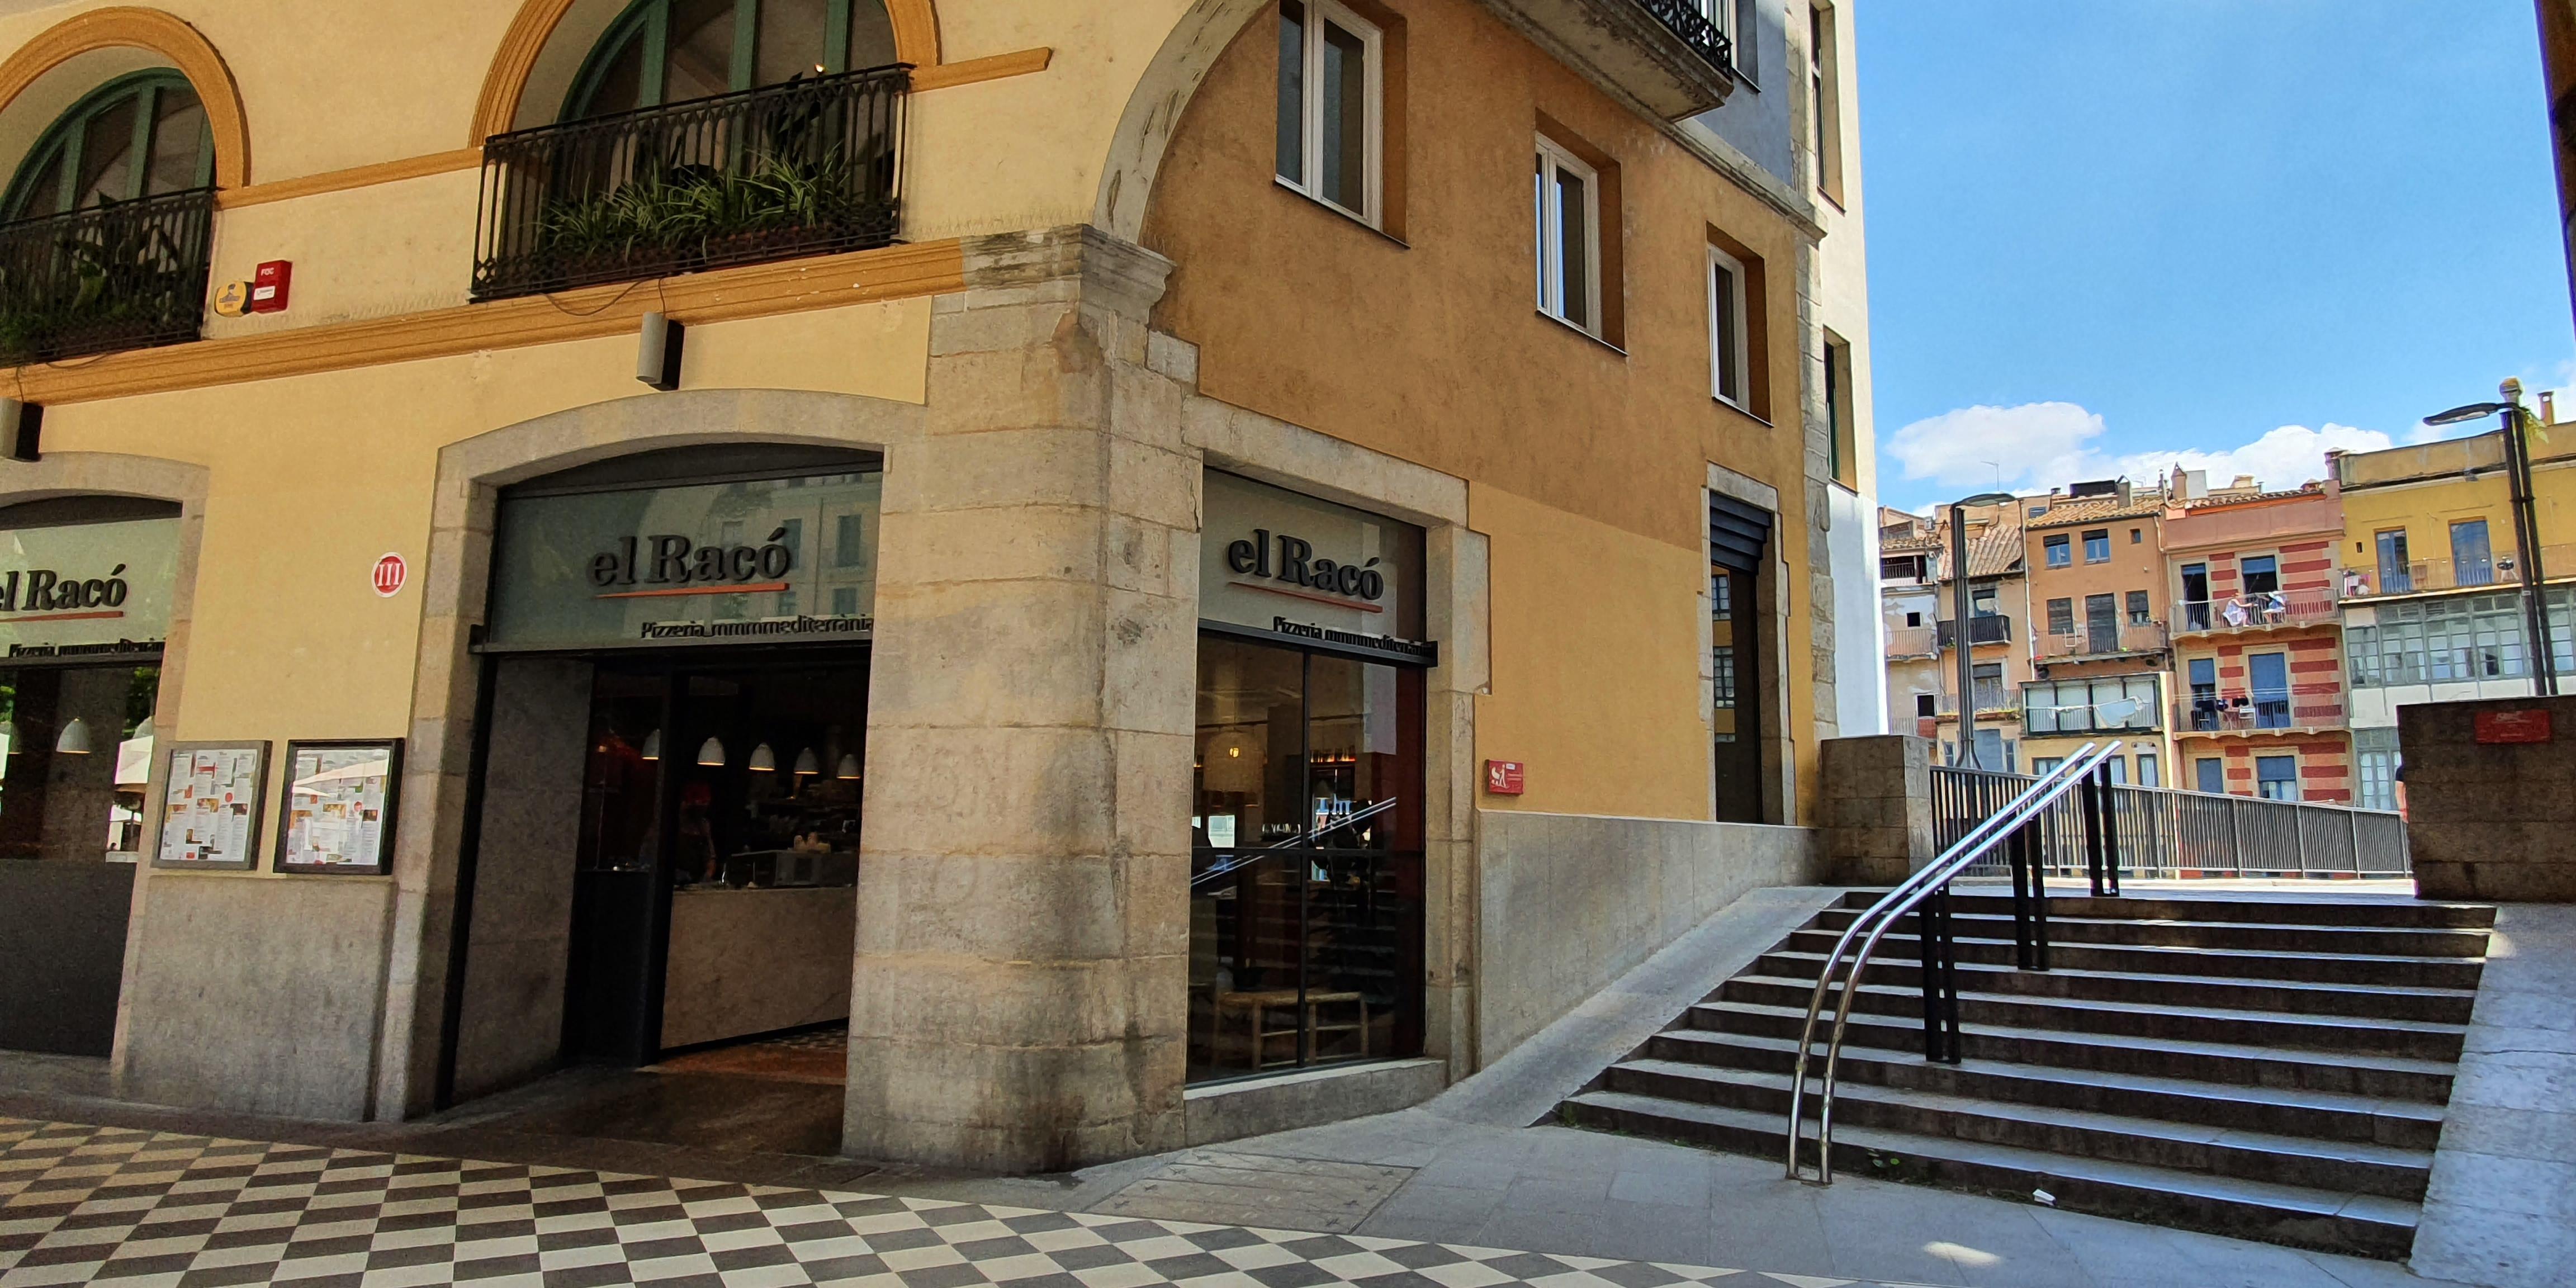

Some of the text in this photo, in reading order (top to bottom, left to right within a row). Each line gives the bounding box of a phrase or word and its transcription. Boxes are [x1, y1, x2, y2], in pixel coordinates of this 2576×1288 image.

[587, 527, 792, 586] el Racó
[1229, 529, 1384, 600] el Racó
[0, 564, 127, 611] l Racó
